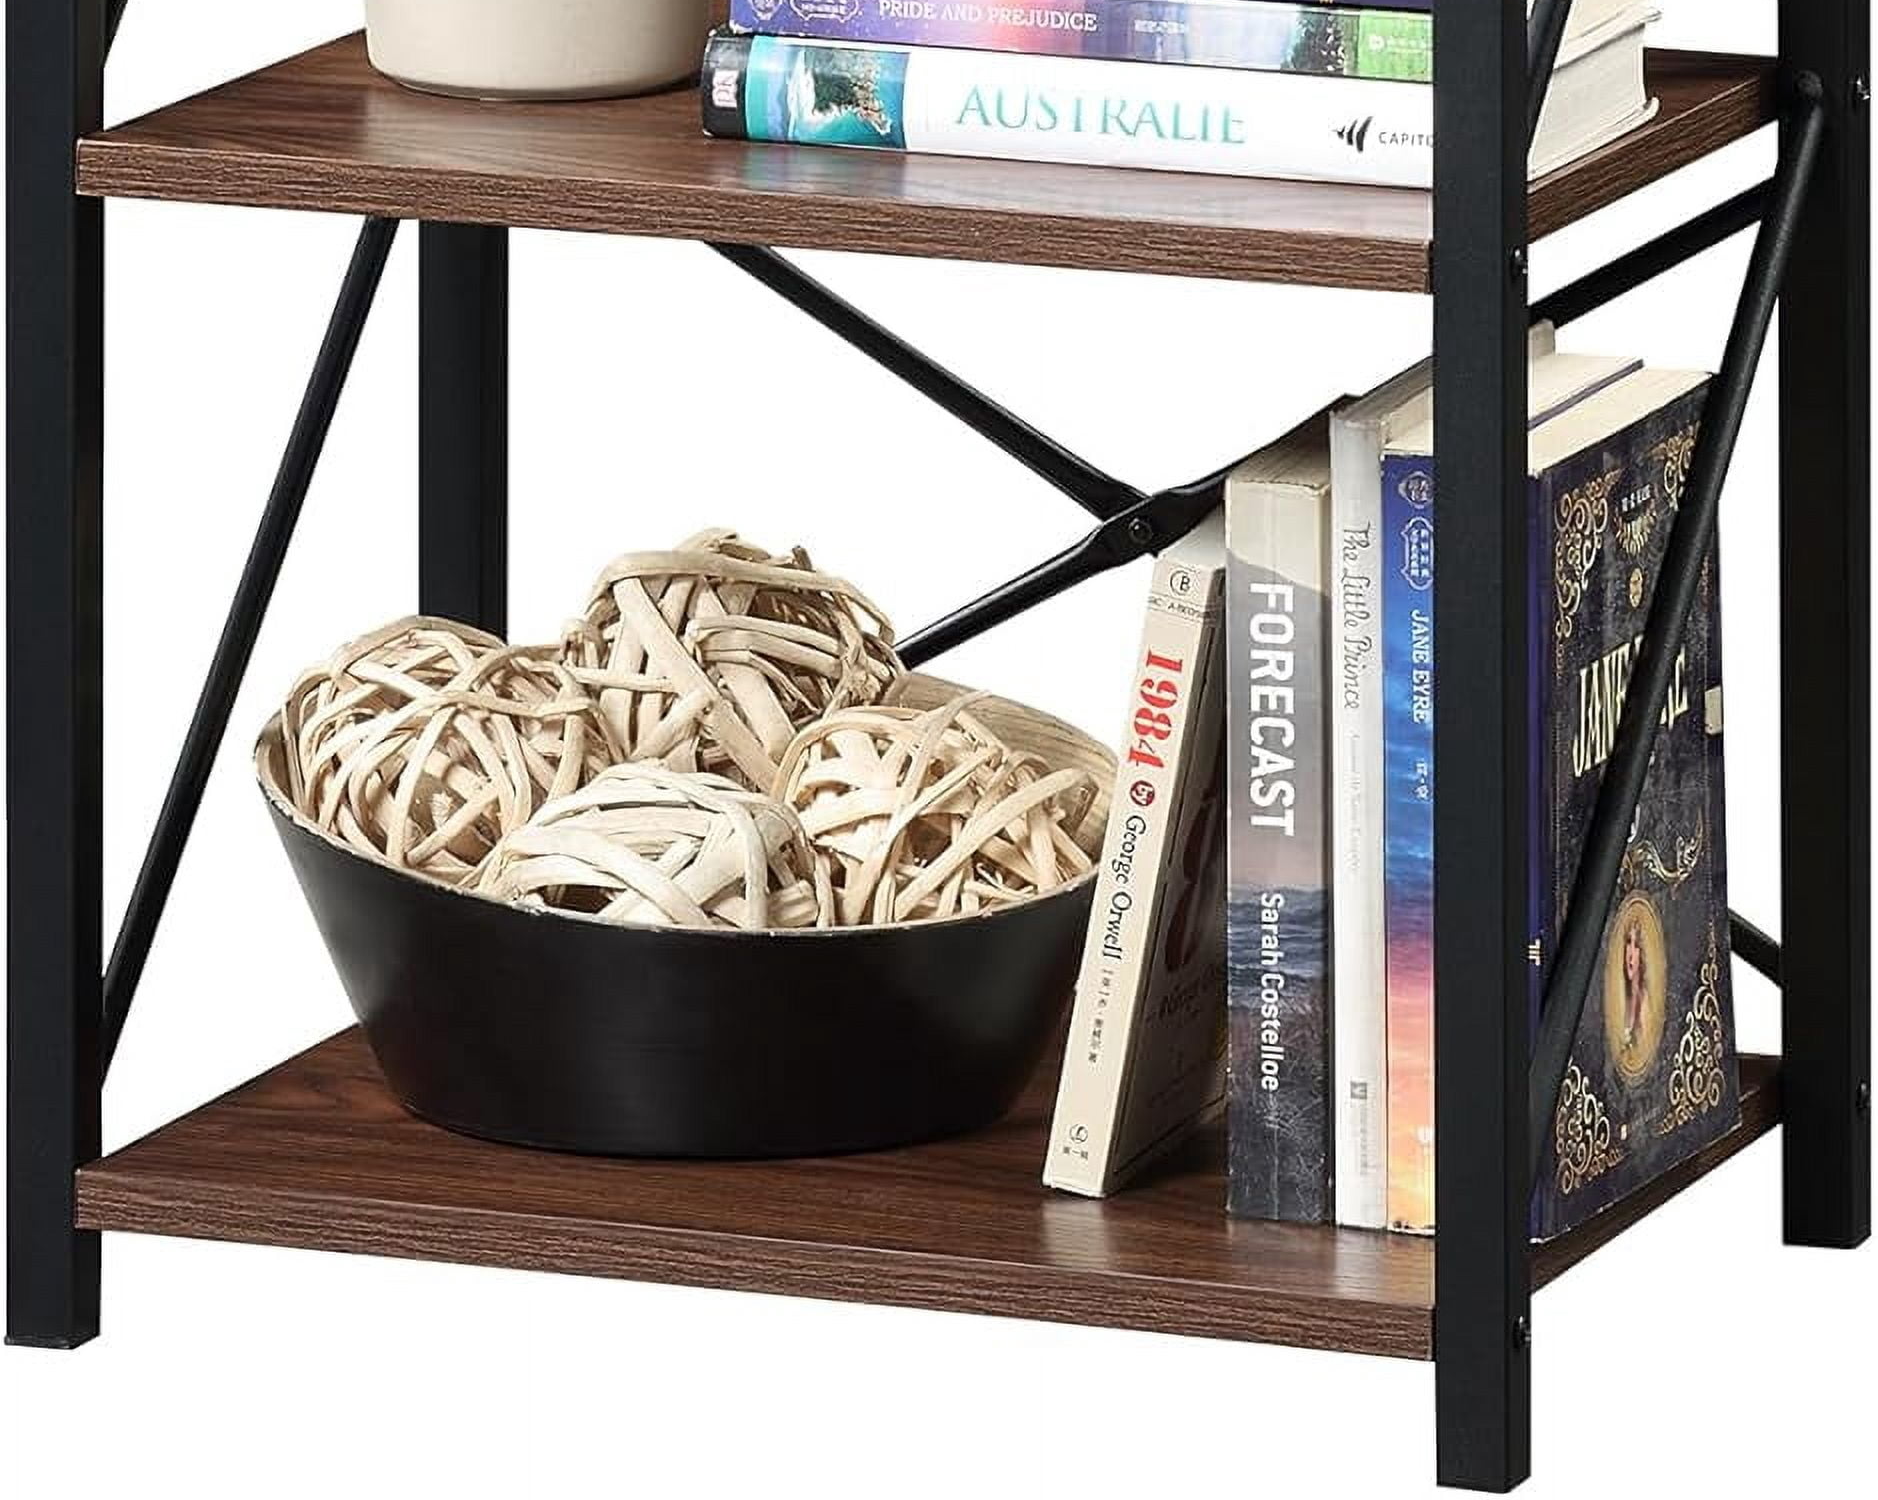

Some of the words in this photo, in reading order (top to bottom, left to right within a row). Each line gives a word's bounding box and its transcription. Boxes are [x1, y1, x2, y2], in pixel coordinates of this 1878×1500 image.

[879, 0, 937, 19] PRIDE
[941, 3, 982, 22] AND
[988, 8, 1098, 32] PREJUDICE
[955, 84, 1246, 145] AUSTRALIE
[1343, 520, 1371, 561] The
[1341, 573, 1371, 628] Little
[1410, 609, 1429, 663] JANE
[1344, 635, 1372, 709] Prince
[1412, 669, 1433, 724] EYRE
[1128, 650, 1183, 768] 1984
[1250, 583, 1295, 837] FORECAST
[1112, 815, 1147, 884] George
[1102, 891, 1133, 960] Orwell
[1261, 892, 1284, 965] Sarah
[1261, 973, 1284, 1091] Costelloe
